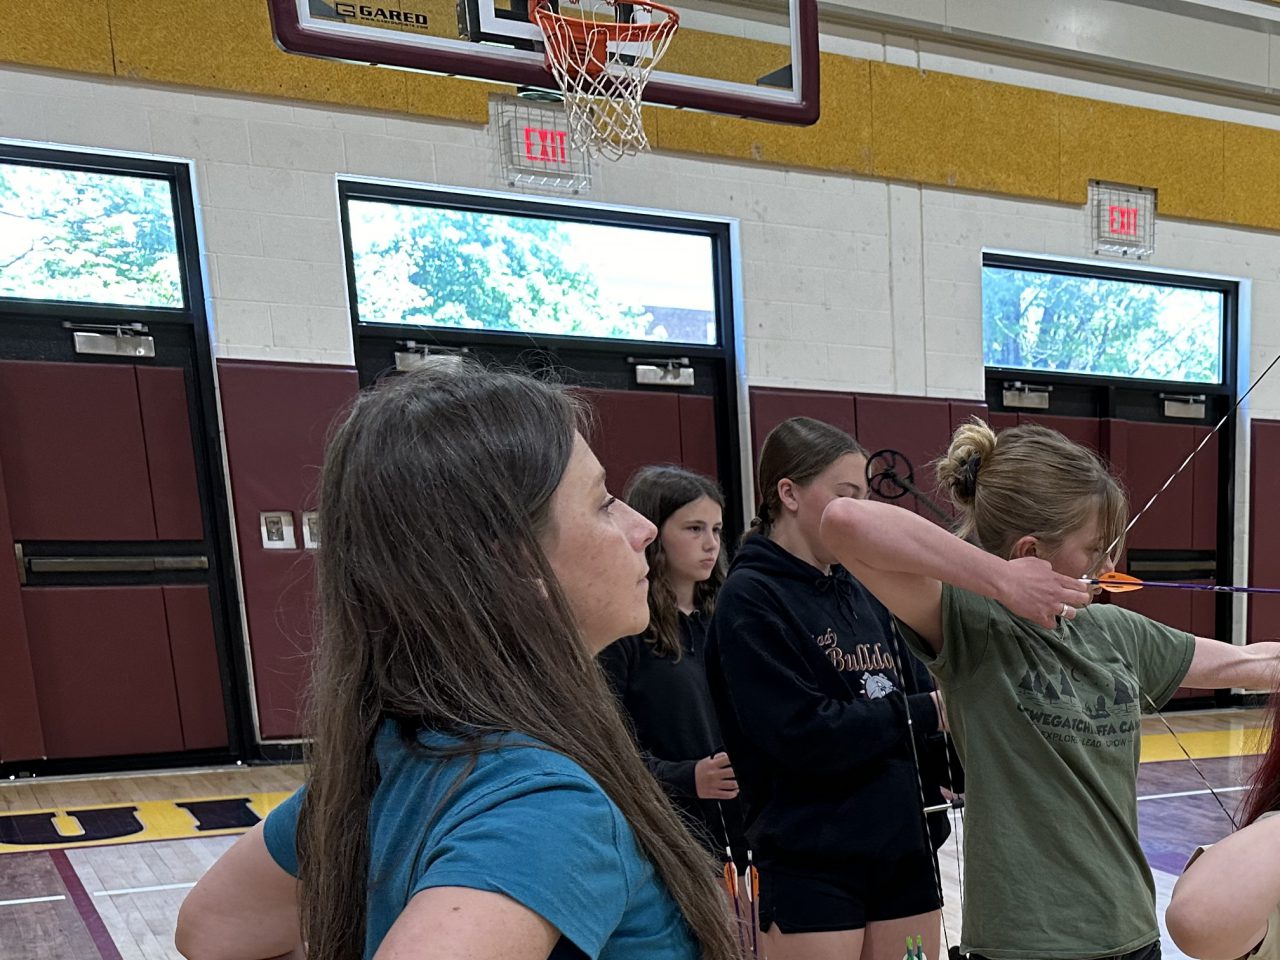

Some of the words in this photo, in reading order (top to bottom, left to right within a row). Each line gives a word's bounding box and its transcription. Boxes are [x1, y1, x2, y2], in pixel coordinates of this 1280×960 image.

[359, 5, 428, 25] GARED
[523, 126, 568, 164] EXIT
[1108, 205, 1138, 235] EXIT
[811, 627, 838, 648] ady
[825, 642, 897, 672] Bulldo
